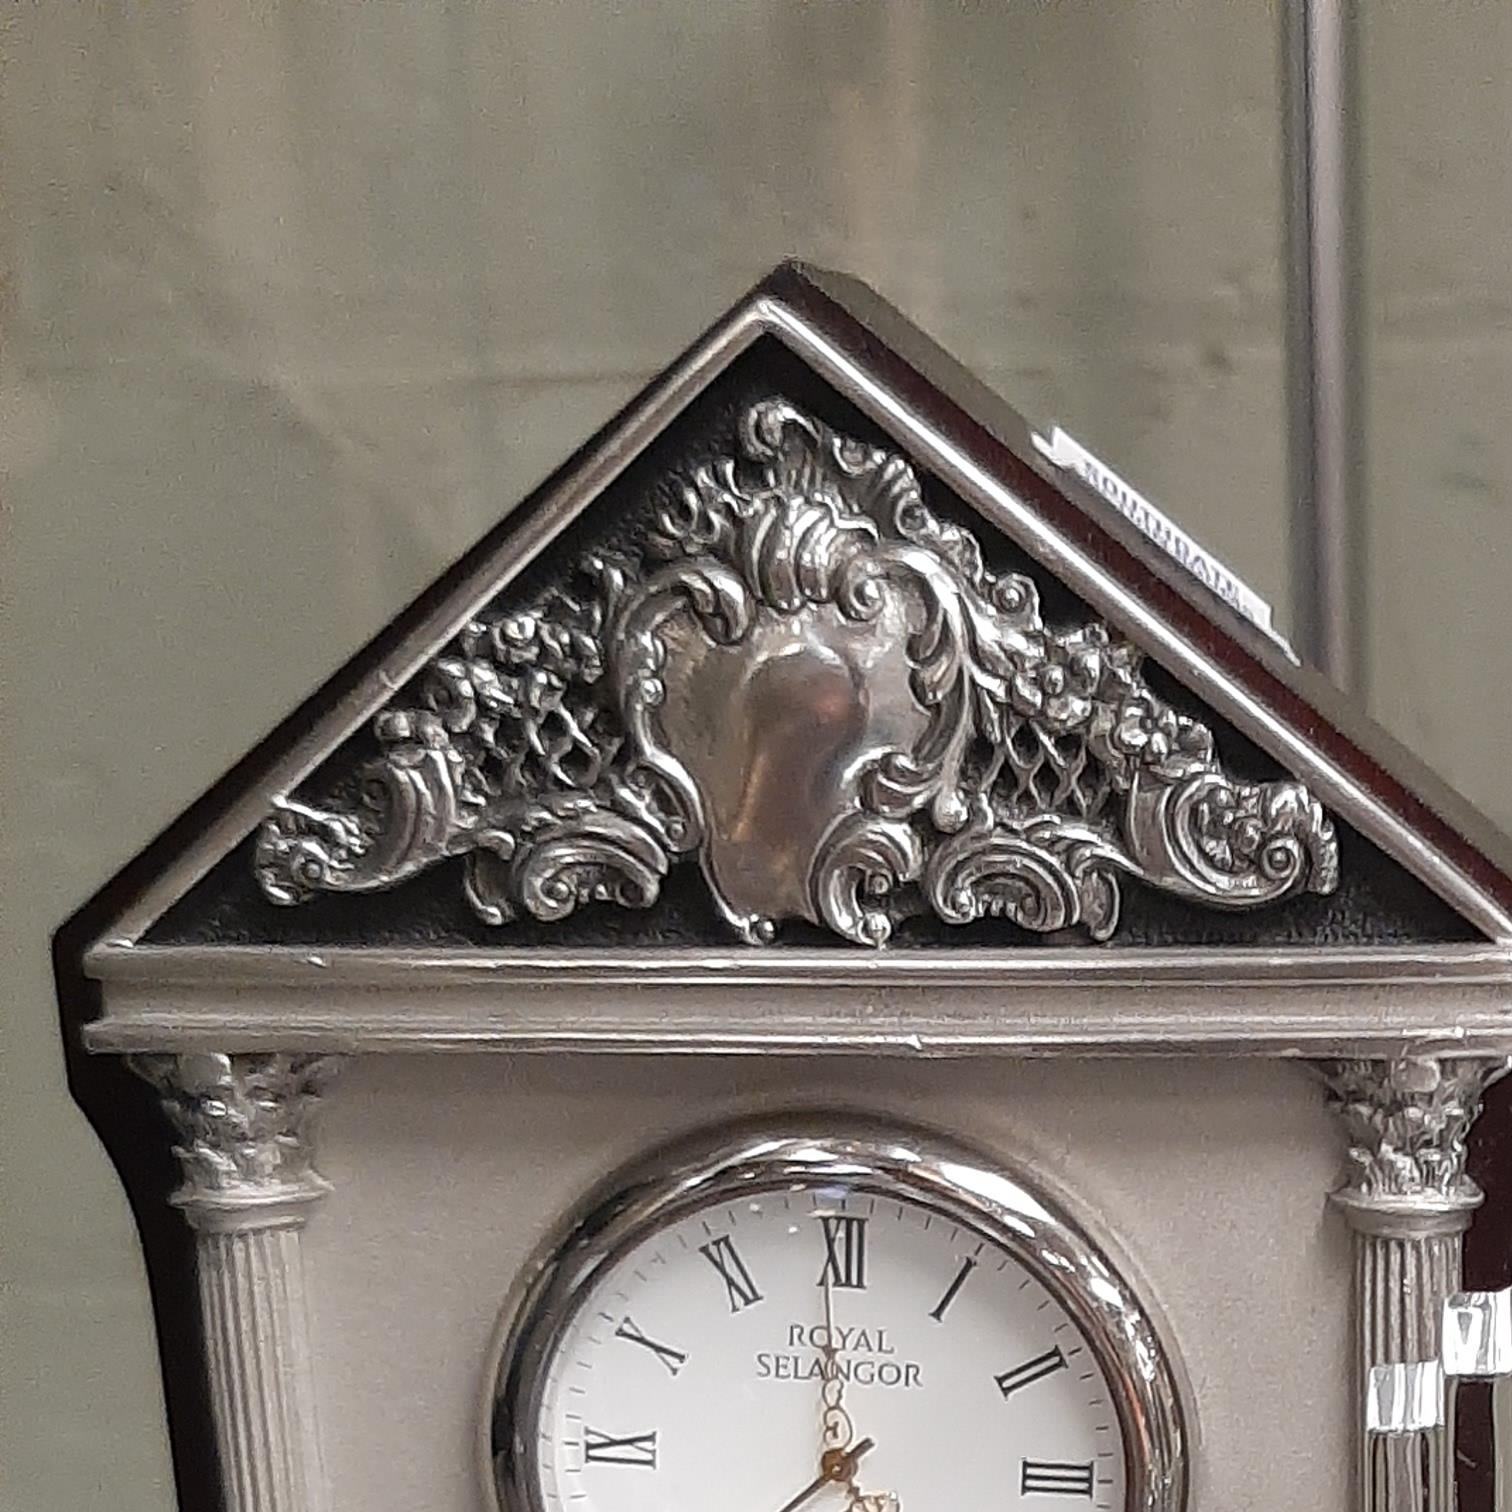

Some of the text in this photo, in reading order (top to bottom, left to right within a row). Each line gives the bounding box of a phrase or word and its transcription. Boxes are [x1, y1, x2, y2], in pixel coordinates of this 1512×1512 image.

[817, 1215, 870, 1289] XII
[788, 1323, 896, 1355] ROYAL
[757, 1352, 924, 1388] SELANGOR
